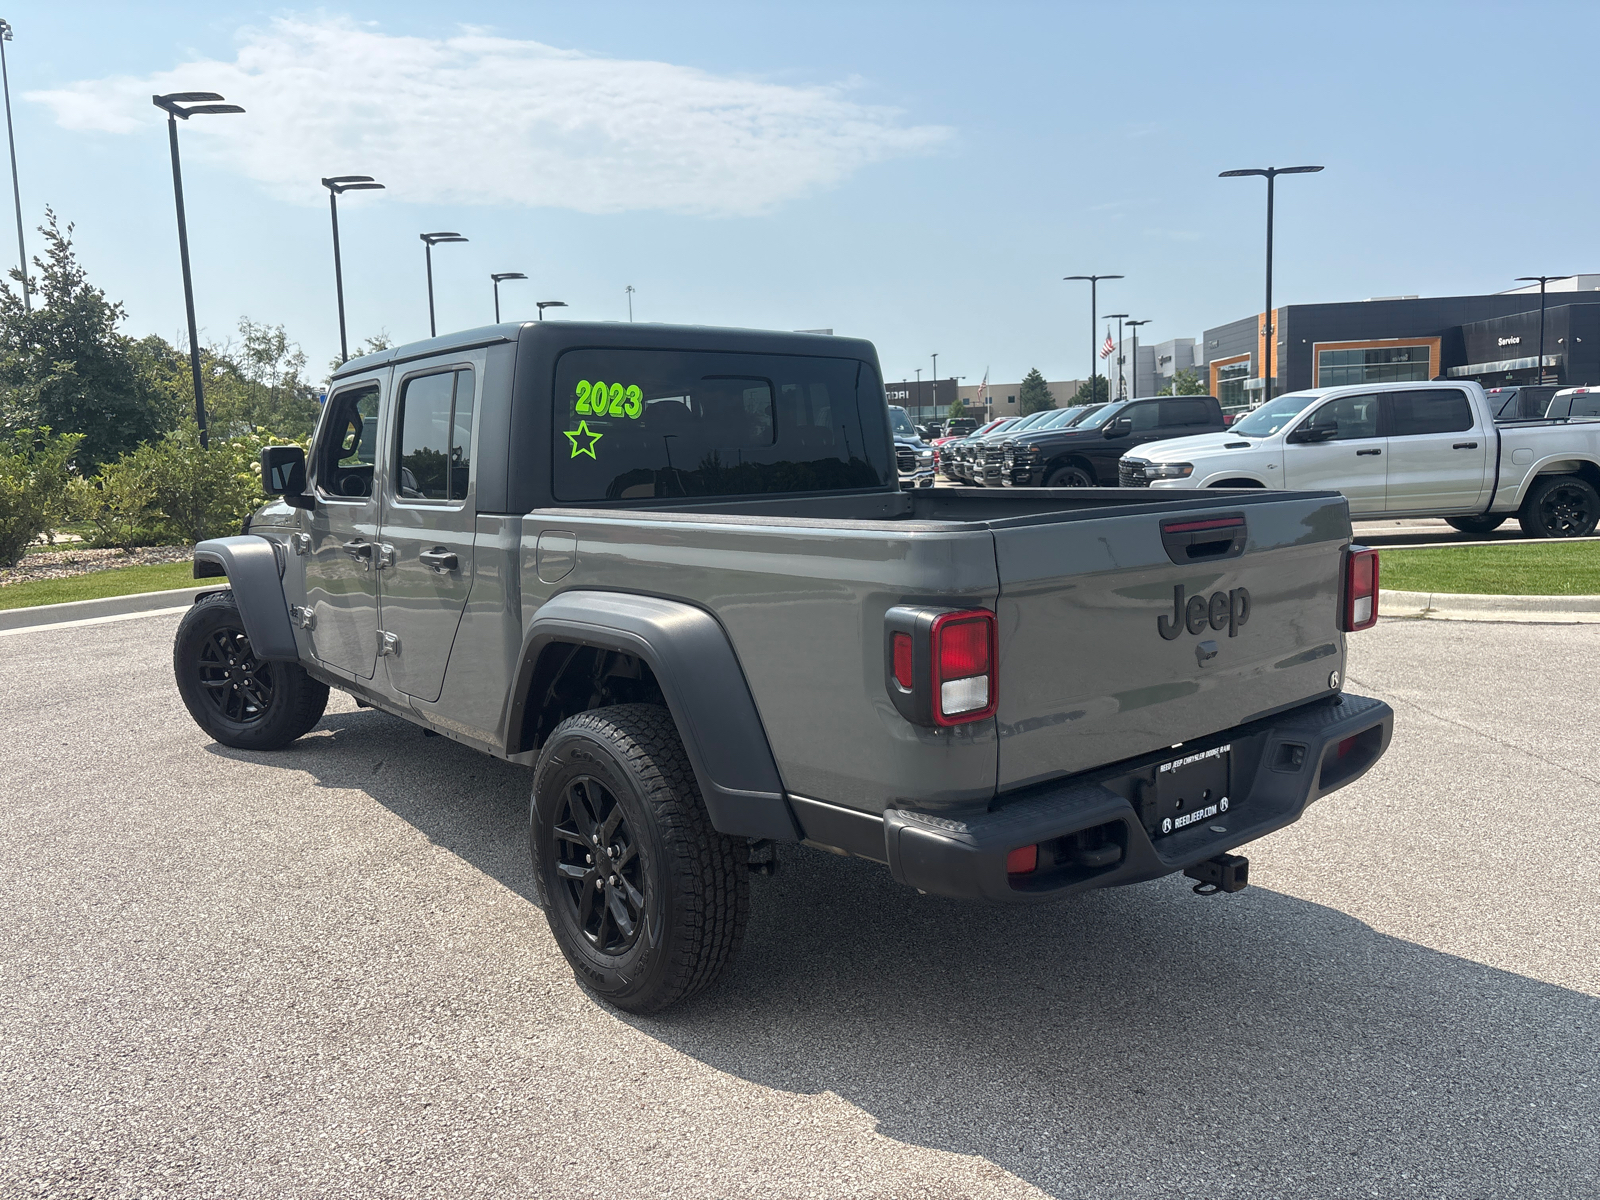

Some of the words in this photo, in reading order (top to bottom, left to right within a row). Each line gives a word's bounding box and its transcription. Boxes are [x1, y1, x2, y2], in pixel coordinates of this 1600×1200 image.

[1498, 336, 1520, 346] Service
[575, 379, 643, 419] 2023
[1157, 585, 1251, 641] Jeep
[1160, 762, 1171, 772] REED
[1172, 759, 1183, 768] JEEP
[1183, 751, 1205, 765] CHRYSLER
[1205, 747, 1219, 757] DODGE
[1219, 744, 1231, 753] RAM
[1174, 804, 1217, 829] REEDJEEP.COM
